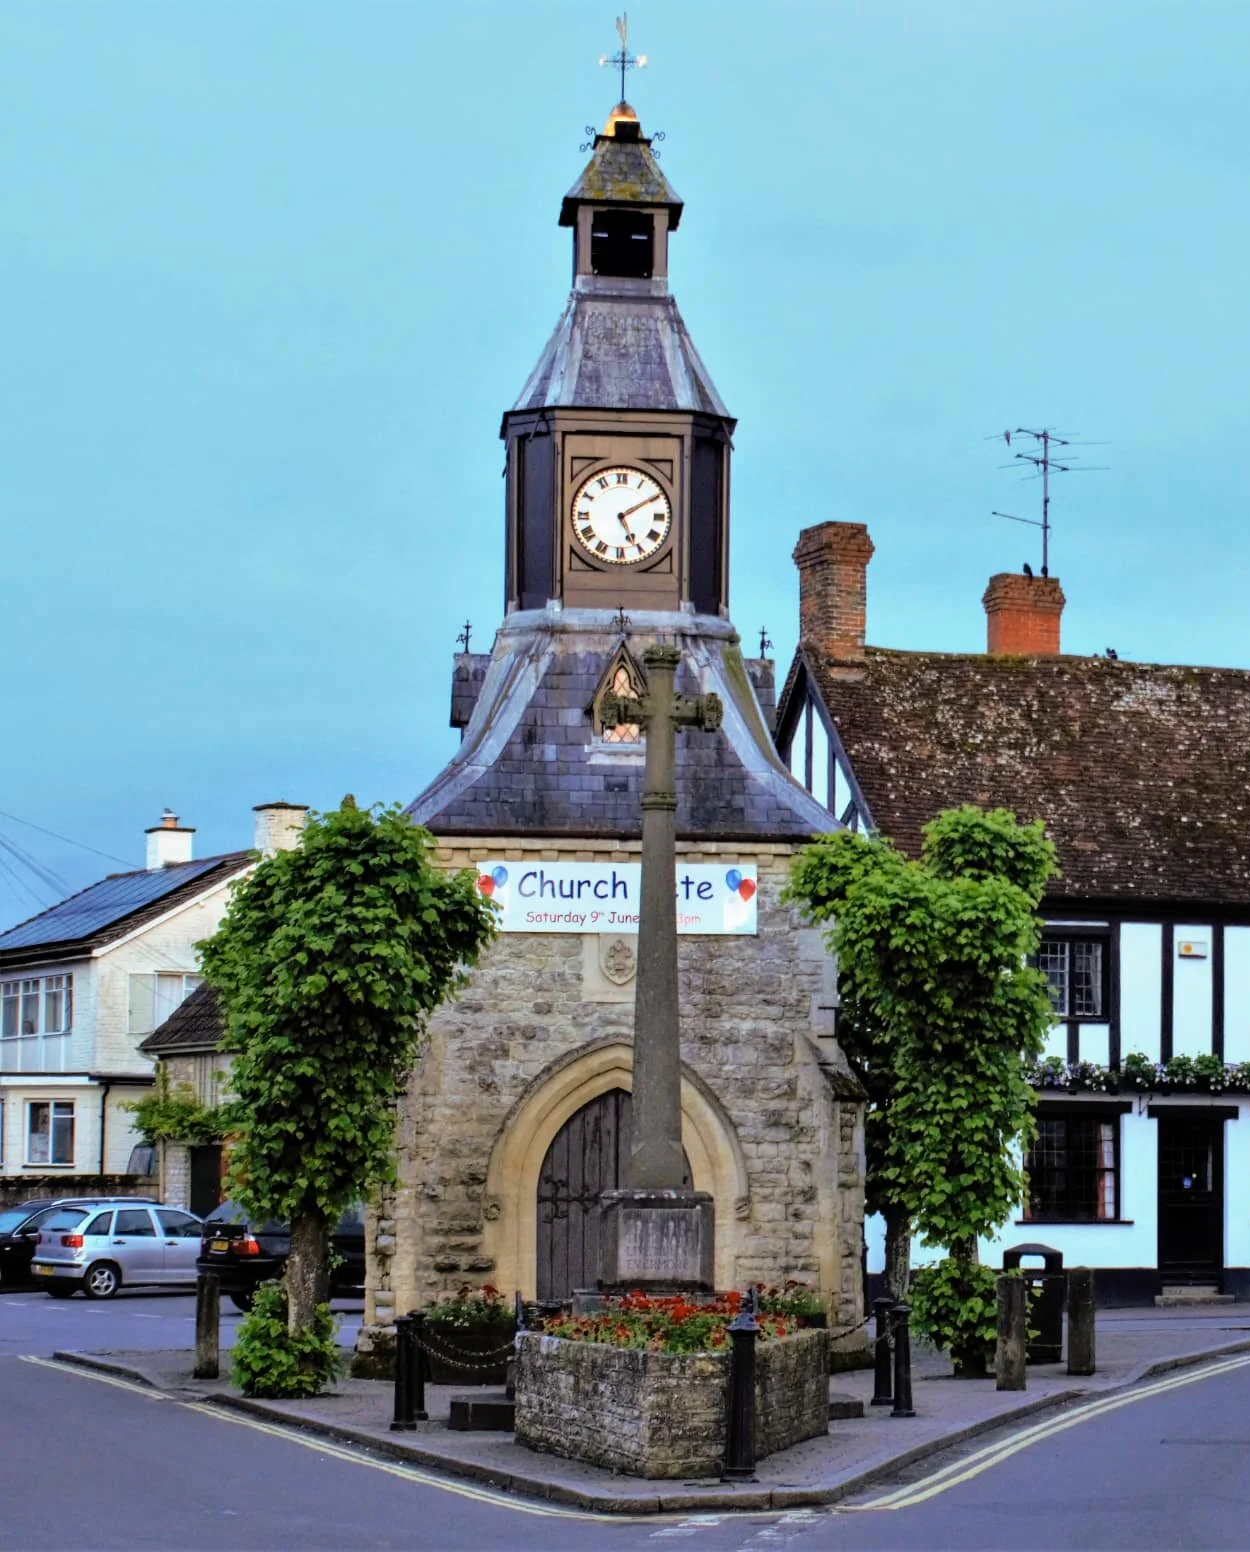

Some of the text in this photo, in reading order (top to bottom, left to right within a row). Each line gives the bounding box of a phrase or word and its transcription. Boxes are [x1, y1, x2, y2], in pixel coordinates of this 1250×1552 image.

[518, 869, 714, 900] Church te
[526, 911, 586, 926] Saturday
[608, 911, 640, 924] June
